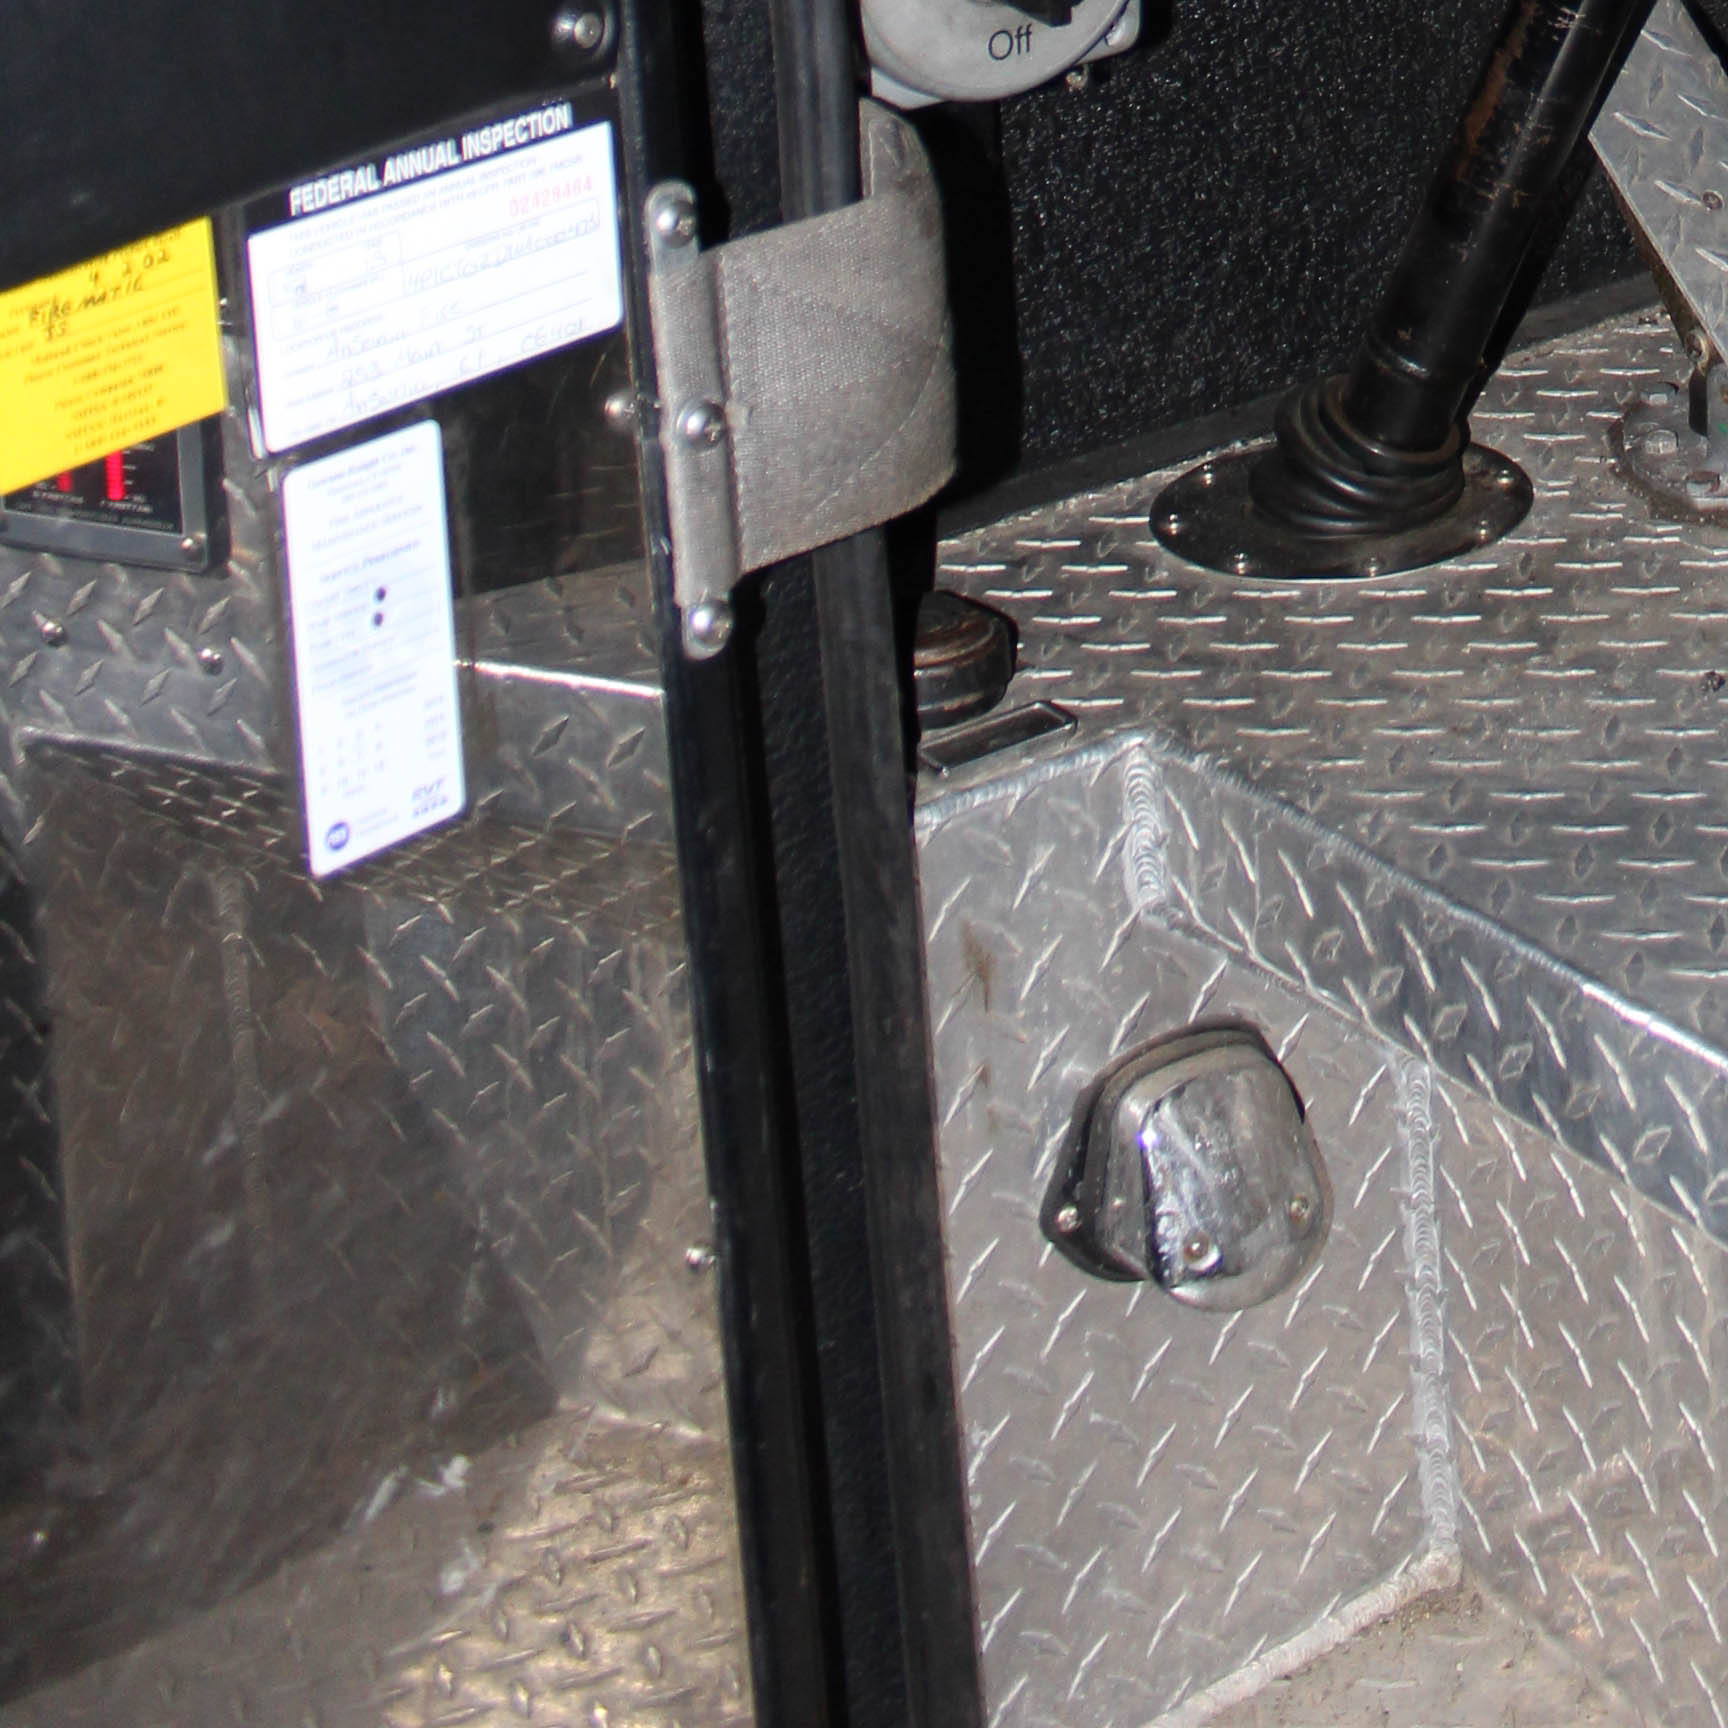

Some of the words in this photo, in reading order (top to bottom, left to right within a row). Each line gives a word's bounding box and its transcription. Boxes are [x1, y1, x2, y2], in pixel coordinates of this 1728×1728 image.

[988, 24, 1032, 61] Off
[290, 163, 380, 217] FEDERAL
[383, 138, 460, 187] ANNUAL
[461, 102, 573, 161] INSPECTION
